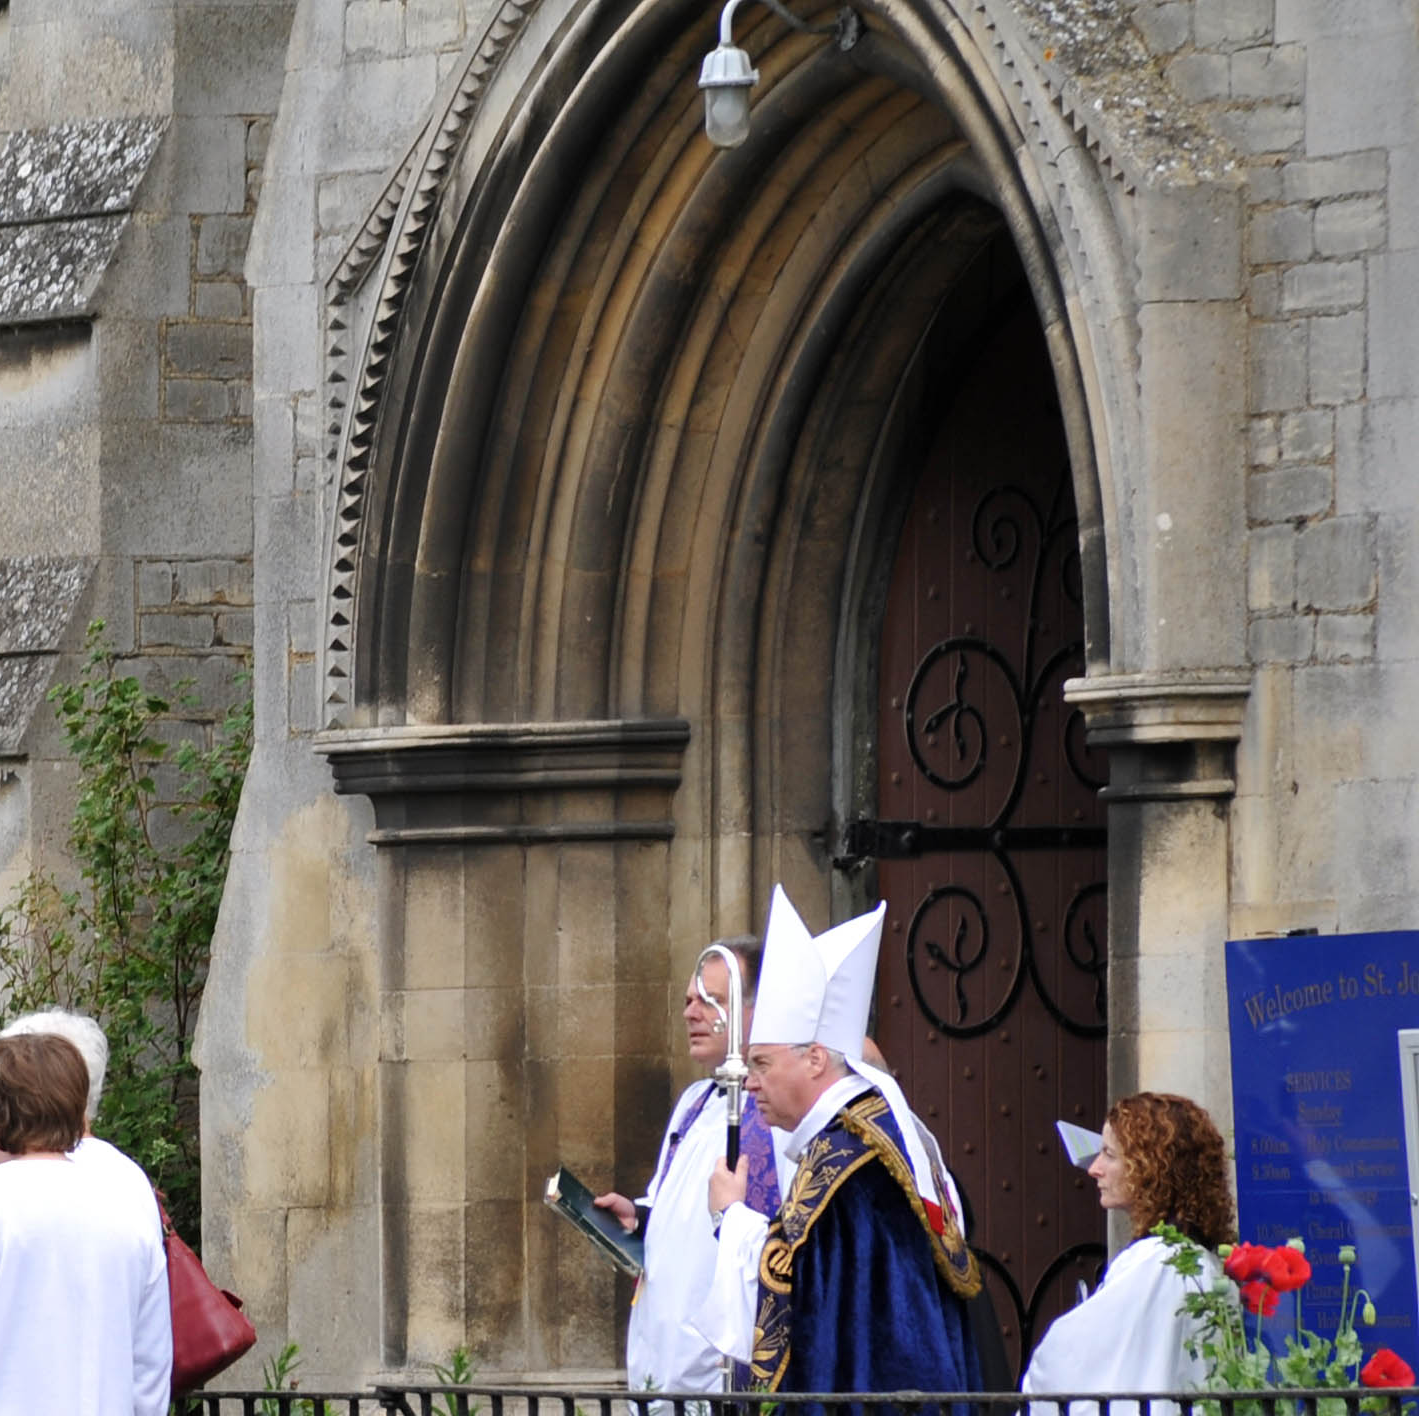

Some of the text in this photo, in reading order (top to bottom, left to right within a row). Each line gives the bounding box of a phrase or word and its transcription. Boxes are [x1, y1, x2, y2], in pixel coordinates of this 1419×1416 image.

[1244, 980, 1334, 1032] Welcome
[1338, 971, 1360, 1000] to
[1364, 963, 1393, 997] St.
[1285, 1070, 1352, 1092] SERVICES
